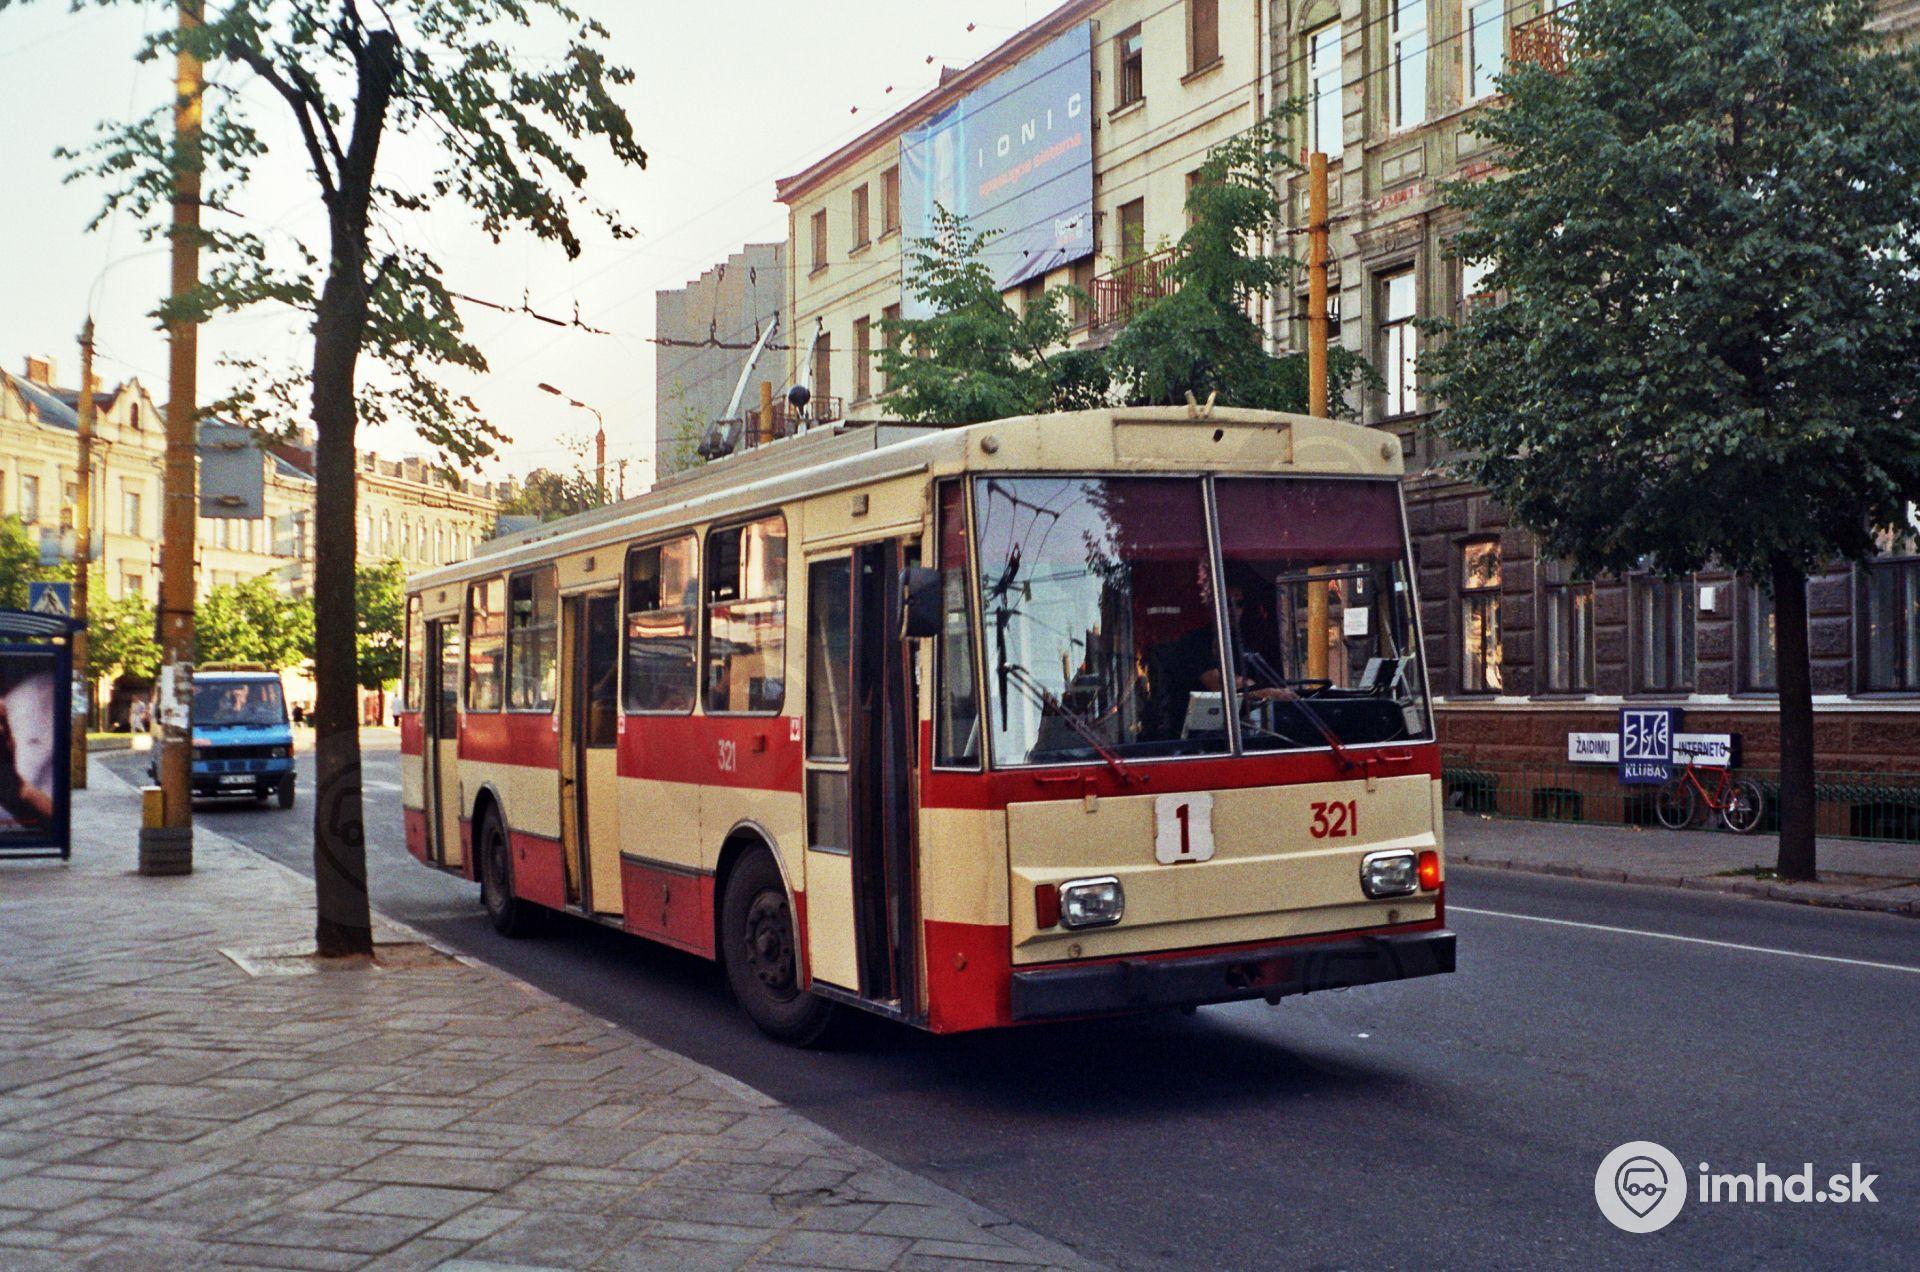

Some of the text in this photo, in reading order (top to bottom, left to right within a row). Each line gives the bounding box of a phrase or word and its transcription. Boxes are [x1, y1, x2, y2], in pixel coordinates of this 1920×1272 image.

[718, 739, 736, 772] 321
[1576, 737, 1610, 758] ŽAIDIMŲ
[1679, 741, 1726, 757] INTERNETO
[1625, 763, 1668, 780] KLUBAS
[1175, 803, 1190, 854] 1
[1309, 800, 1358, 839] 321
